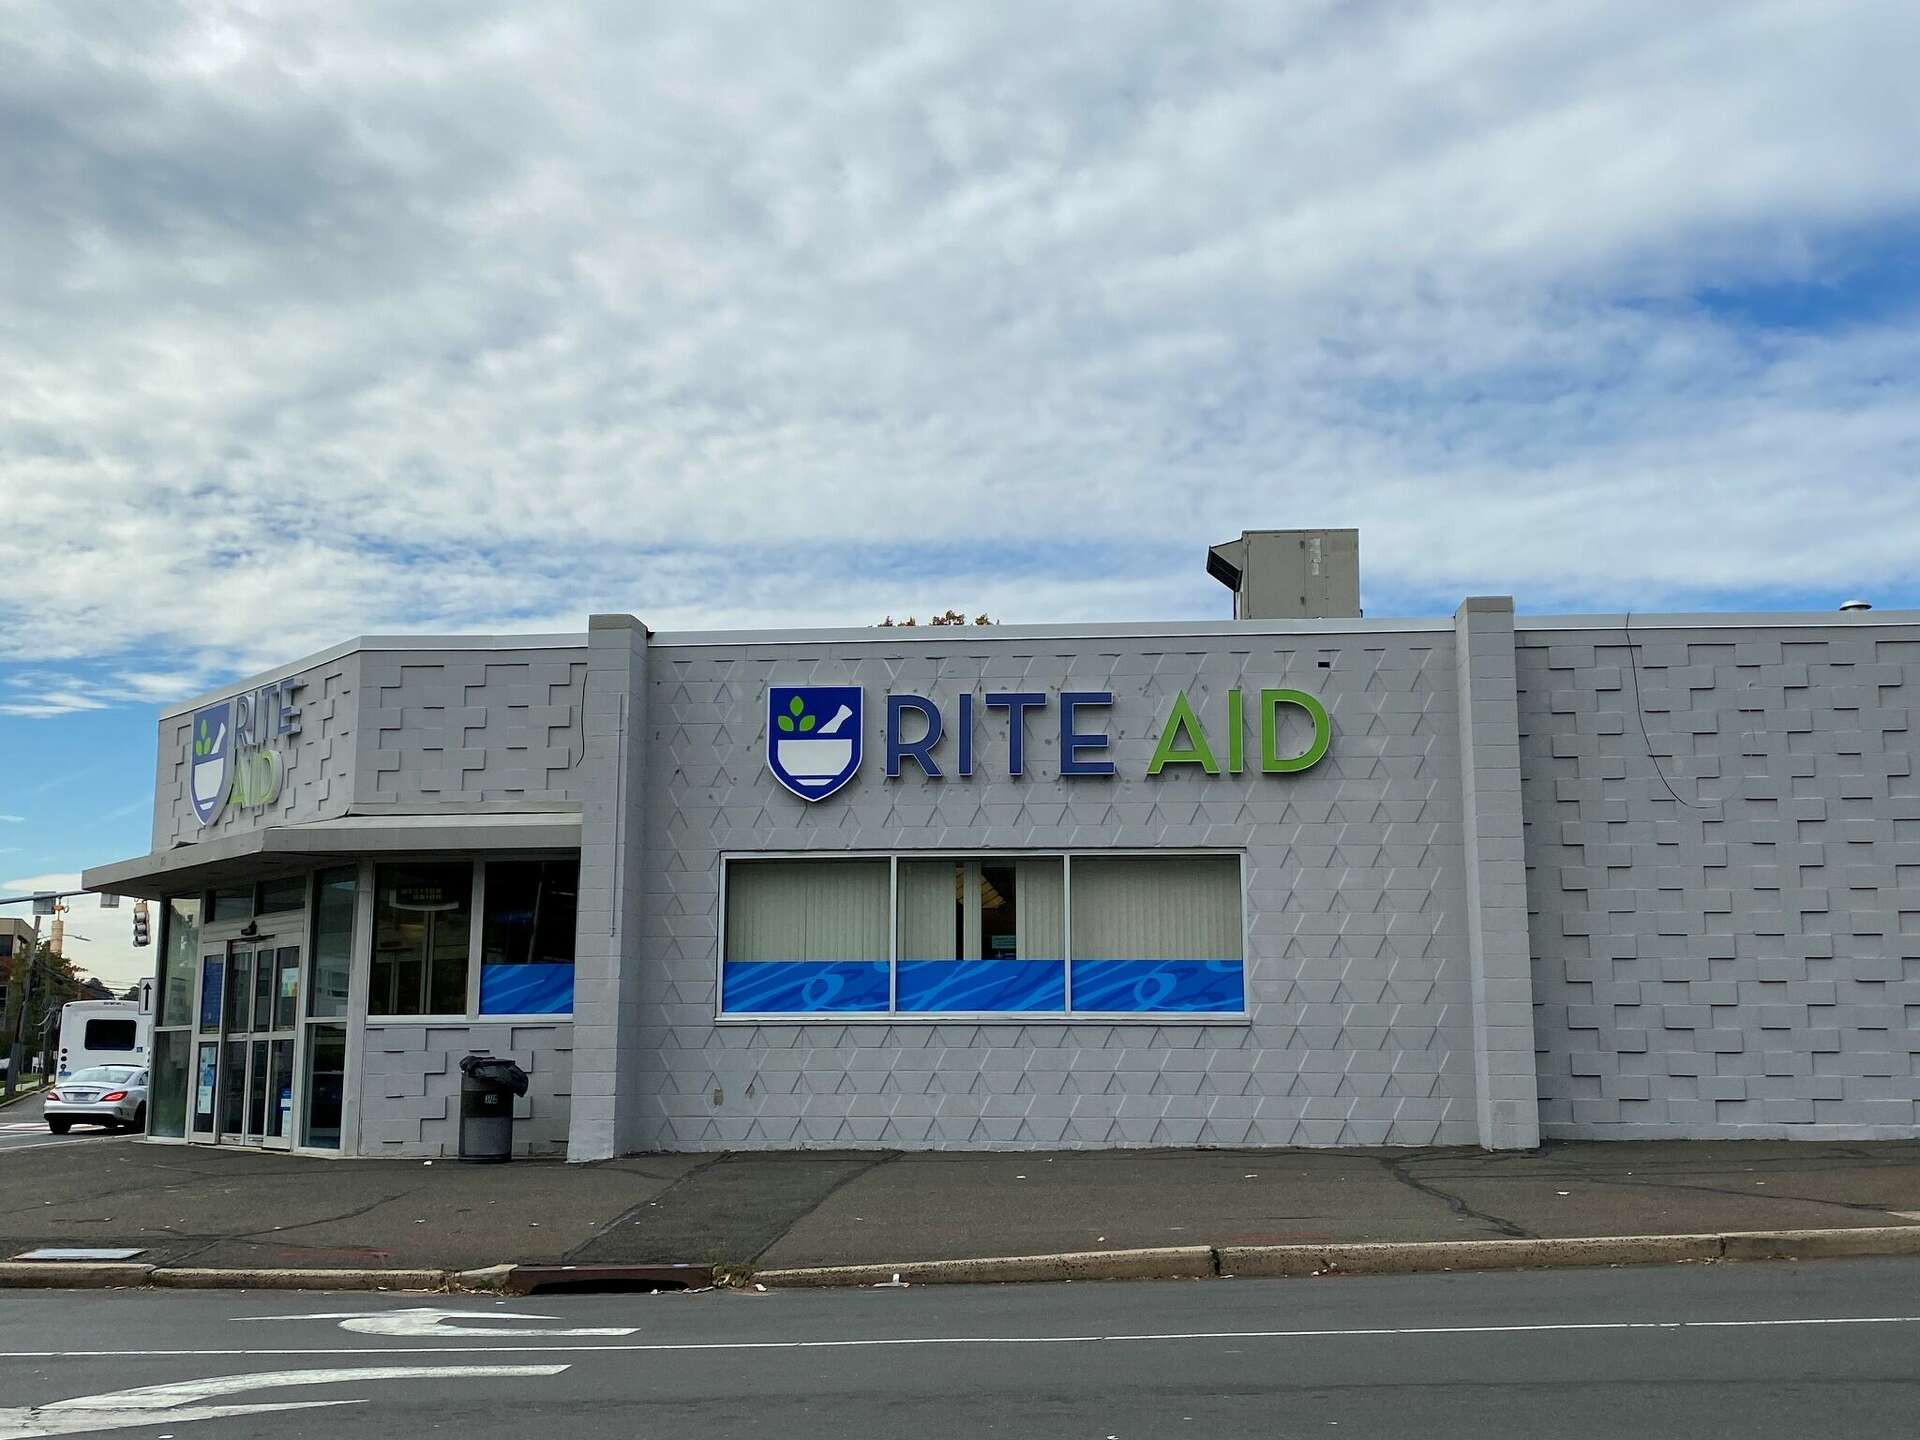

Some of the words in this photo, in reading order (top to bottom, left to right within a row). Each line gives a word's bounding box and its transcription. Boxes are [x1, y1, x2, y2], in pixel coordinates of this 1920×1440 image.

[235, 678, 299, 745] RITE
[885, 691, 1115, 777] RITE
[1146, 688, 1331, 775] AID
[231, 750, 283, 808] AID
